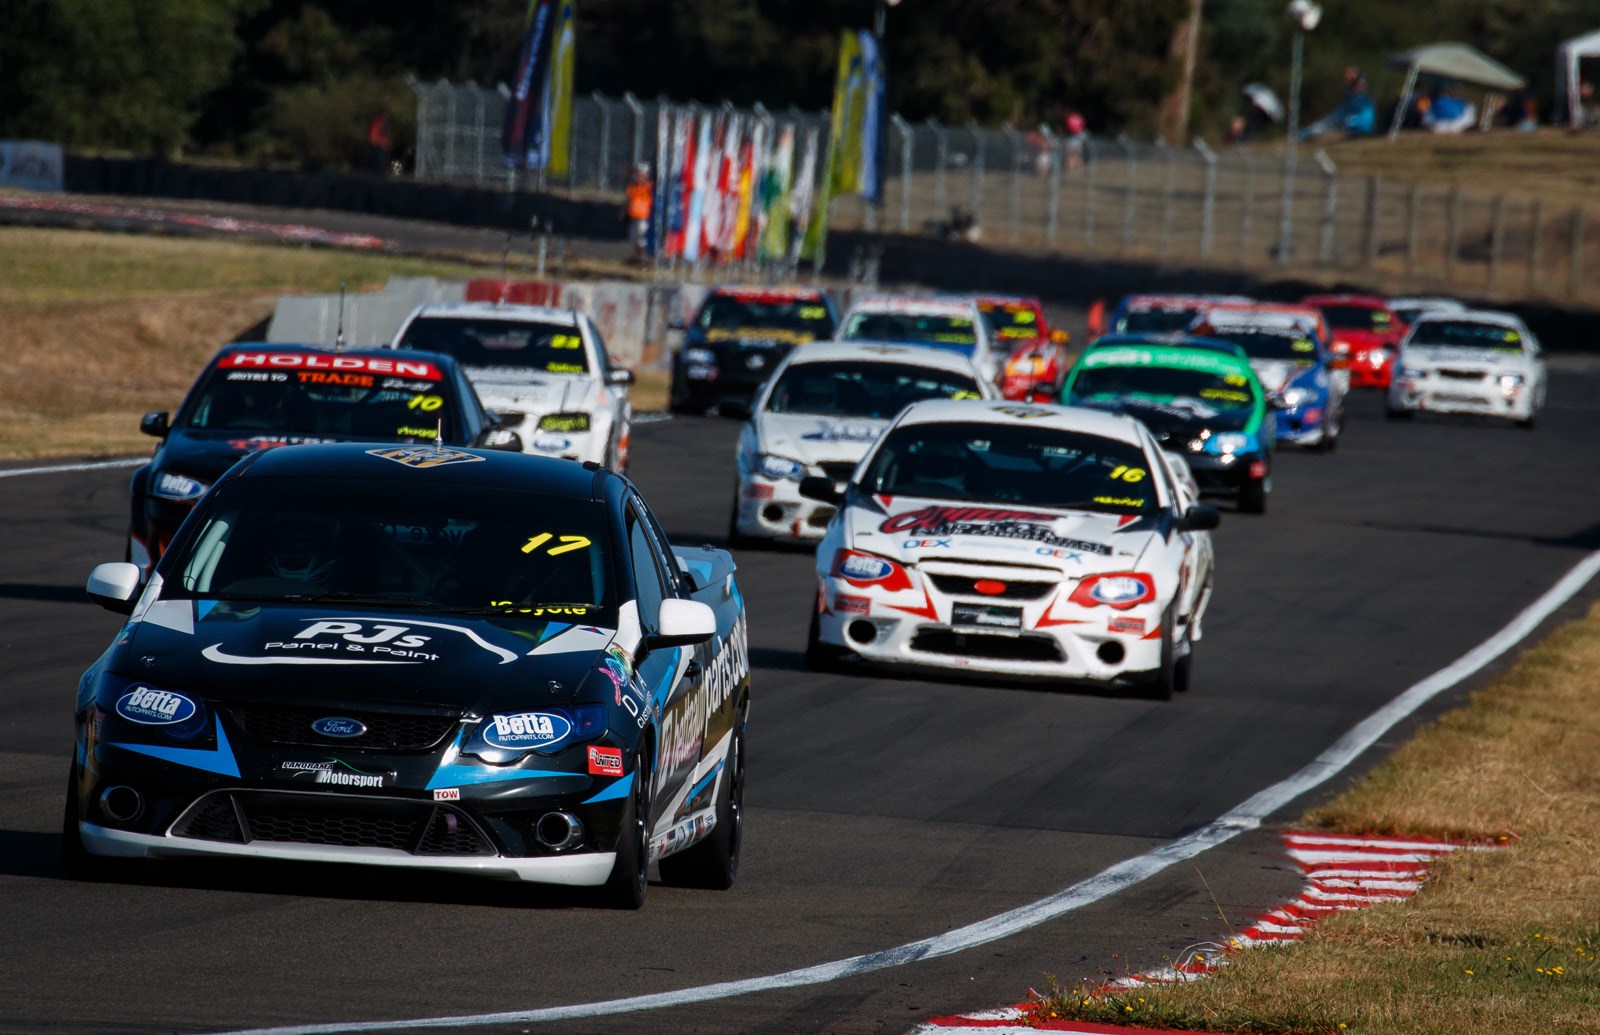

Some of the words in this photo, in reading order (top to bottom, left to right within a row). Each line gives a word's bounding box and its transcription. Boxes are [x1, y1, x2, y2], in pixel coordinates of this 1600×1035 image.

[233, 354, 428, 376] HOLDEN
[296, 371, 375, 388] TRADE
[407, 394, 444, 412] 10
[1109, 464, 1146, 483] 16
[521, 532, 591, 556] 17
[903, 539, 952, 549] OEX
[1035, 547, 1083, 564] OEX
[293, 621, 432, 648] PJs
[264, 641, 338, 651] Panel
[347, 643, 368, 653] &
[373, 646, 440, 661] Paint
[128, 686, 182, 715] Betta
[124, 705, 173, 721] AUTOPARTS.COM
[322, 719, 354, 734] Ford
[493, 714, 554, 736] Betta
[498, 733, 555, 742] AUTOPARTS.COM
[281, 761, 333, 771] PANORAMA
[319, 770, 384, 788] Motorsport
[435, 790, 458, 800] TOW
